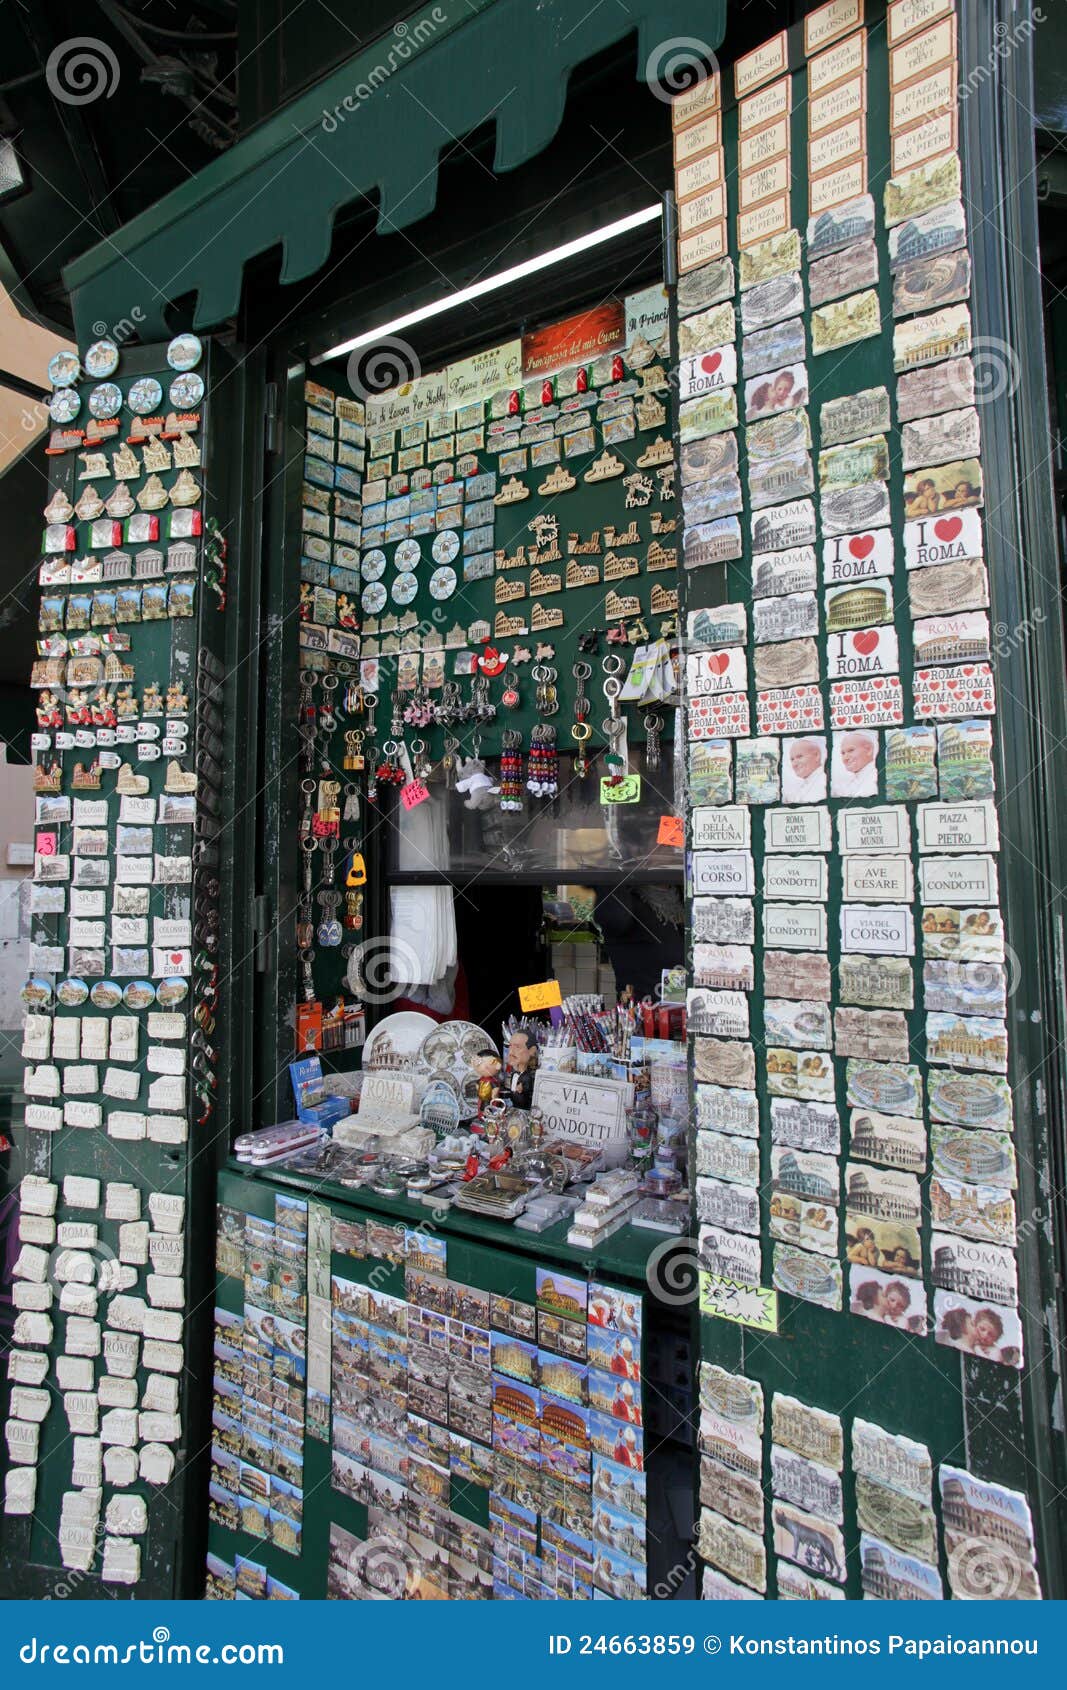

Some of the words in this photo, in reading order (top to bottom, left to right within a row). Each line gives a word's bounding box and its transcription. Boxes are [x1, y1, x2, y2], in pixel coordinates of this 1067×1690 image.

[809, 8, 856, 41] COLOSSEO
[821, 47, 850, 66] PIAZZA
[908, 50, 933, 69] TREVI
[739, 54, 781, 82] COLOSSEO
[813, 70, 827, 83] SAN
[831, 52, 861, 75] PIETRO
[750, 89, 777, 108] PIAZZA
[821, 89, 850, 109] PIAZZA
[905, 80, 939, 103] PIAZZA
[742, 111, 755, 124] SAN
[759, 97, 785, 118] PIETRO
[813, 111, 827, 124] SAN
[831, 94, 860, 115] PIETRO
[896, 105, 912, 118] SAN
[916, 87, 950, 110] PIETRO
[749, 129, 776, 148] CAMPO
[820, 130, 849, 149] PIAZZA
[906, 125, 939, 147] PIAZZA
[751, 143, 776, 161] FIORI
[812, 153, 826, 164] SAN
[830, 136, 859, 156] PIETRO
[896, 149, 912, 162] SAN
[916, 132, 950, 150] PIETRO
[750, 167, 777, 185] CAMPO
[822, 172, 851, 190] PIAZZA
[751, 180, 776, 197] FIORI
[813, 194, 828, 206] SAN
[831, 179, 861, 198] PIETRO
[688, 195, 713, 212] CAMPO
[749, 208, 775, 224] PIAZZA
[741, 224, 755, 237] SAN
[758, 213, 784, 231] PIETRO
[682, 240, 720, 263] COLOSSEO
[913, 316, 947, 333] ROMA
[474, 358, 497, 372] HOTEL
[689, 358, 697, 380] I
[689, 372, 725, 394] ROMA
[770, 504, 809, 521] ROMA
[702, 522, 731, 535] ROMA
[917, 522, 928, 548] I
[832, 538, 843, 563] I
[917, 542, 968, 564] ROMA
[773, 551, 812, 567] ROMA
[832, 560, 878, 579] ROMA
[928, 622, 968, 634] ROMA
[837, 633, 847, 658] I
[695, 656, 703, 678] I
[837, 656, 883, 674] ROMA
[931, 668, 964, 680] ROMA
[695, 676, 733, 693] ROMA
[845, 682, 873, 693] ROMA
[958, 678, 992, 690] ROMA
[701, 697, 725, 707] ROMA
[770, 690, 796, 700] ROMA
[870, 689, 900, 701] ROMA
[921, 691, 954, 703] ROMA
[721, 704, 747, 715] ROMA
[792, 698, 820, 709] ROMA
[837, 704, 866, 716] ROMA
[951, 702, 984, 713] ROMA
[694, 718, 718, 728] ROMA
[762, 712, 789, 722] ROMA
[787, 719, 814, 730] ROMA
[864, 712, 893, 723] ROMA
[715, 724, 741, 735] ROMA
[711, 815, 728, 823] VIA
[785, 816, 804, 824] ROMA
[861, 816, 881, 825] ROMA
[939, 814, 968, 824] PIAZZA
[703, 823, 734, 832] DELLA
[785, 825, 805, 834] CAPUT
[860, 826, 882, 835] CAPUT
[698, 832, 742, 841] FORTUNA
[785, 834, 807, 843] MUNDI
[860, 836, 884, 845] MUNDI
[937, 833, 971, 844] PIETRO
[701, 872, 742, 883] CORSO
[865, 868, 887, 877] AVE
[770, 877, 818, 887] CONDOTTI
[854, 879, 899, 889] CESARE
[927, 880, 985, 890] CONDOTTI
[769, 926, 817, 937] CONDOTTI
[851, 928, 900, 940] CORSO
[163, 965, 185, 974] ROMA
[706, 994, 742, 1007] ROMA
[563, 1087, 589, 1105] VIA
[566, 1106, 581, 1116] DEI
[152, 1242, 181, 1253] ROMA
[719, 1235, 756, 1257] ROMA
[956, 1244, 1008, 1269] ROMA
[969, 1486, 1015, 1513] ROMA
